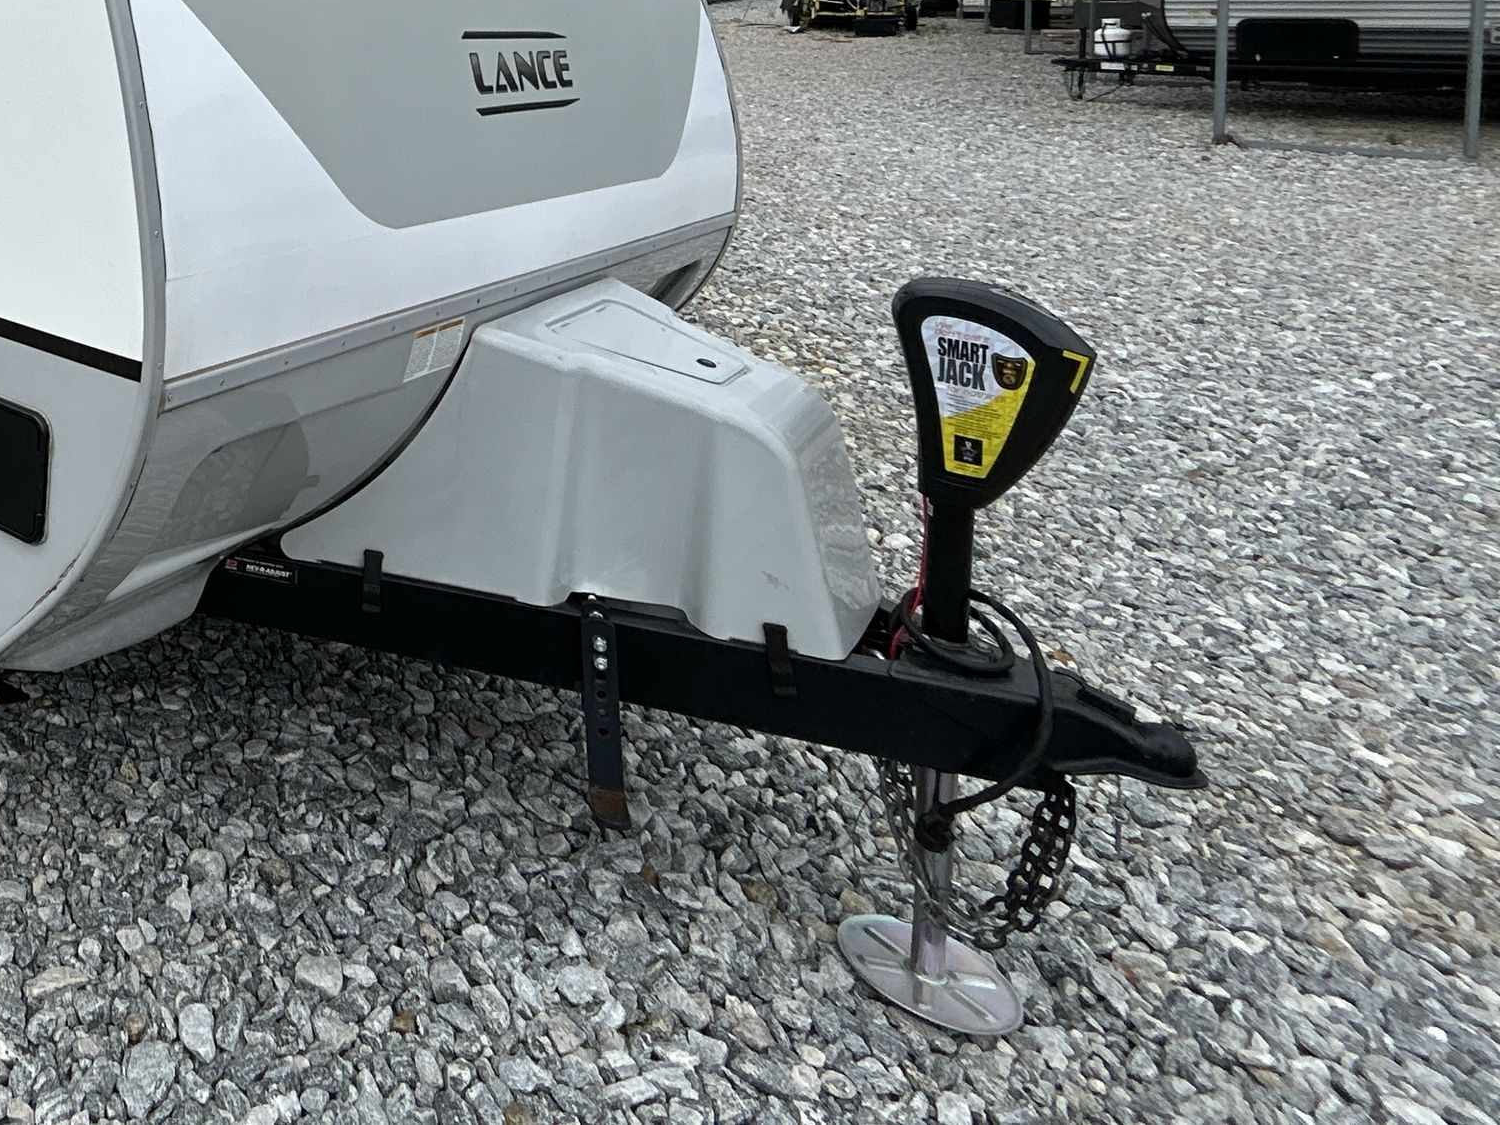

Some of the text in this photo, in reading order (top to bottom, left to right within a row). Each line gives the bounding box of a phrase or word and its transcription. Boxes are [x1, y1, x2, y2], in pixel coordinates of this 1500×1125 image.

[469, 50, 573, 95] LANCE
[937, 337, 989, 365] SMART
[937, 357, 985, 391] JACK
